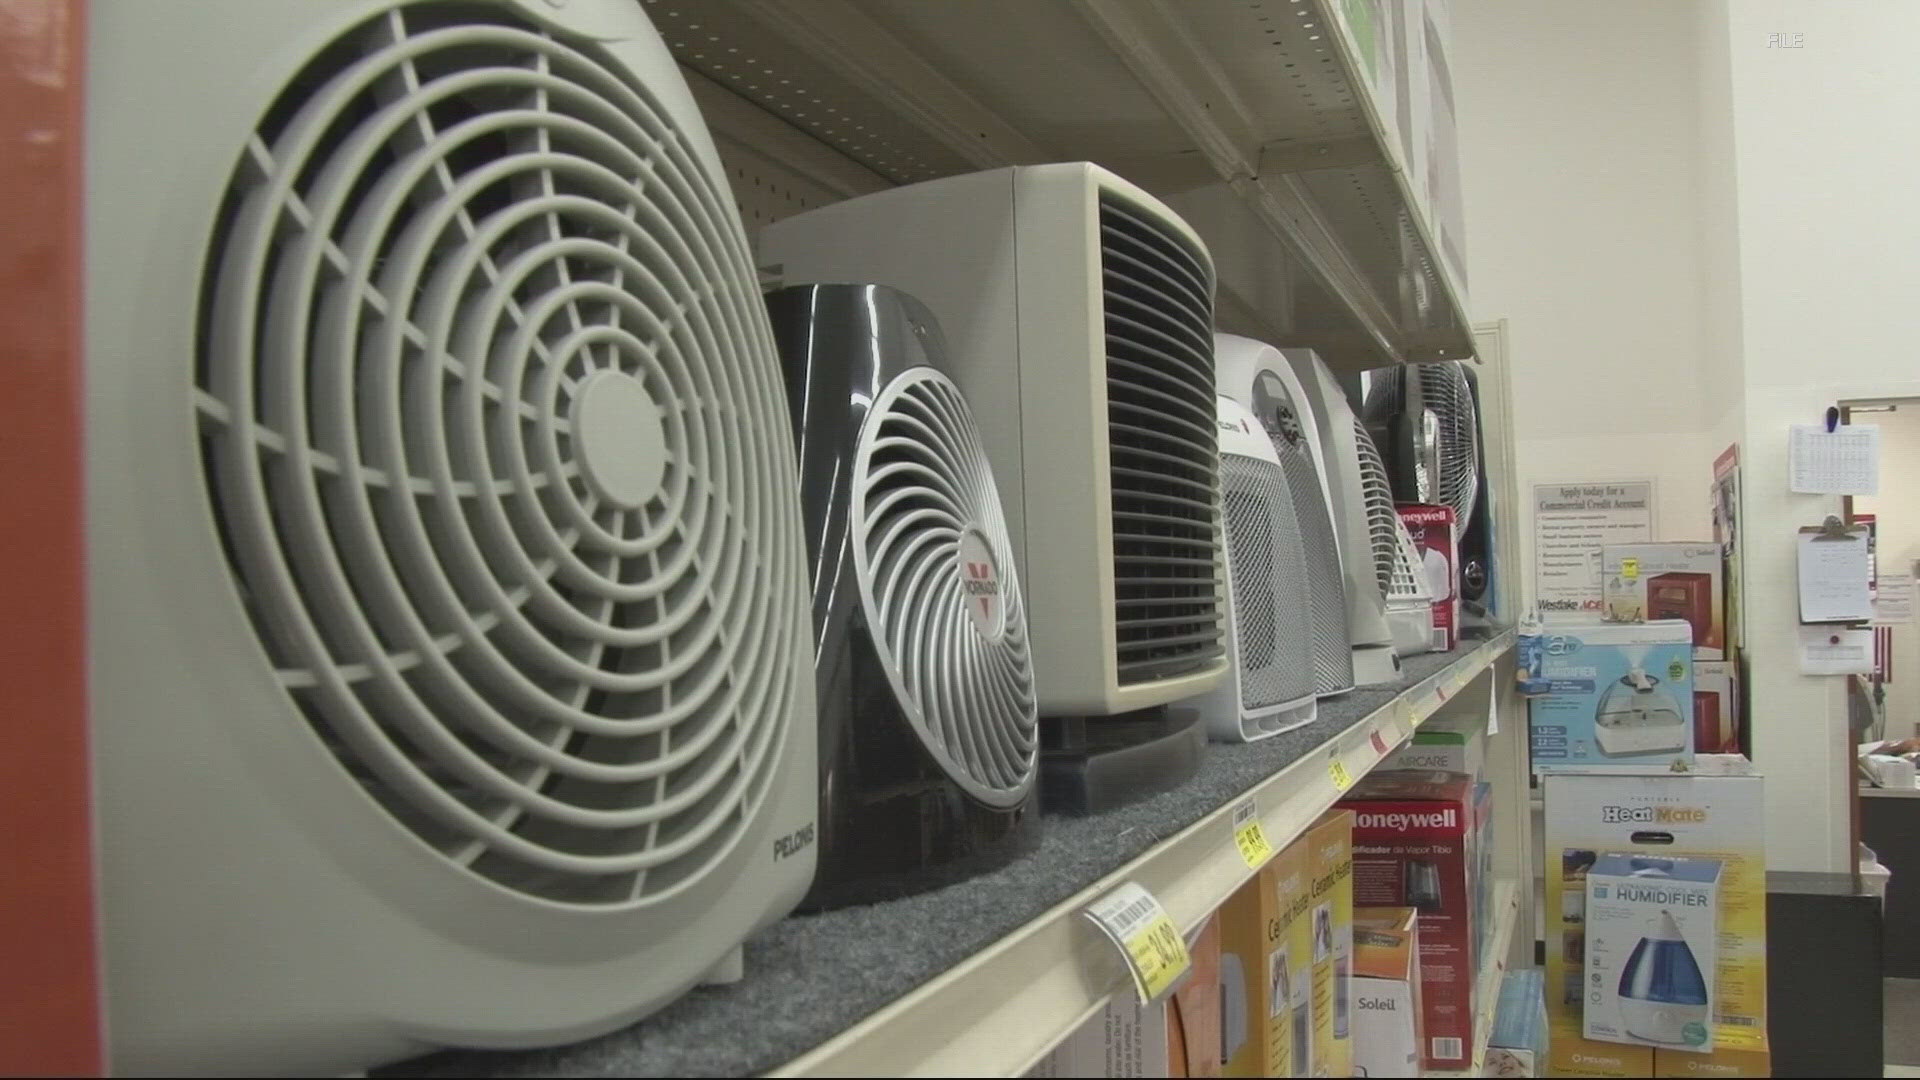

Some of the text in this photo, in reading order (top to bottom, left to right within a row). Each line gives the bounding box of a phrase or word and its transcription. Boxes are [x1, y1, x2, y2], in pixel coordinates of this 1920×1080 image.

[1560, 486, 1581, 499] Apply
[1583, 486, 1604, 498] today
[1606, 485, 1618, 496] for
[1540, 498, 1646, 510] Commercial Credit Account
[1402, 510, 1446, 524] neywell
[1538, 599, 1579, 611] Westlake
[1397, 755, 1449, 768] AIRCARE
[1602, 805, 1707, 824] Heat Mate
[1616, 888, 1708, 907] HUMIDIFIER
[1358, 997, 1396, 1011] Soleil
